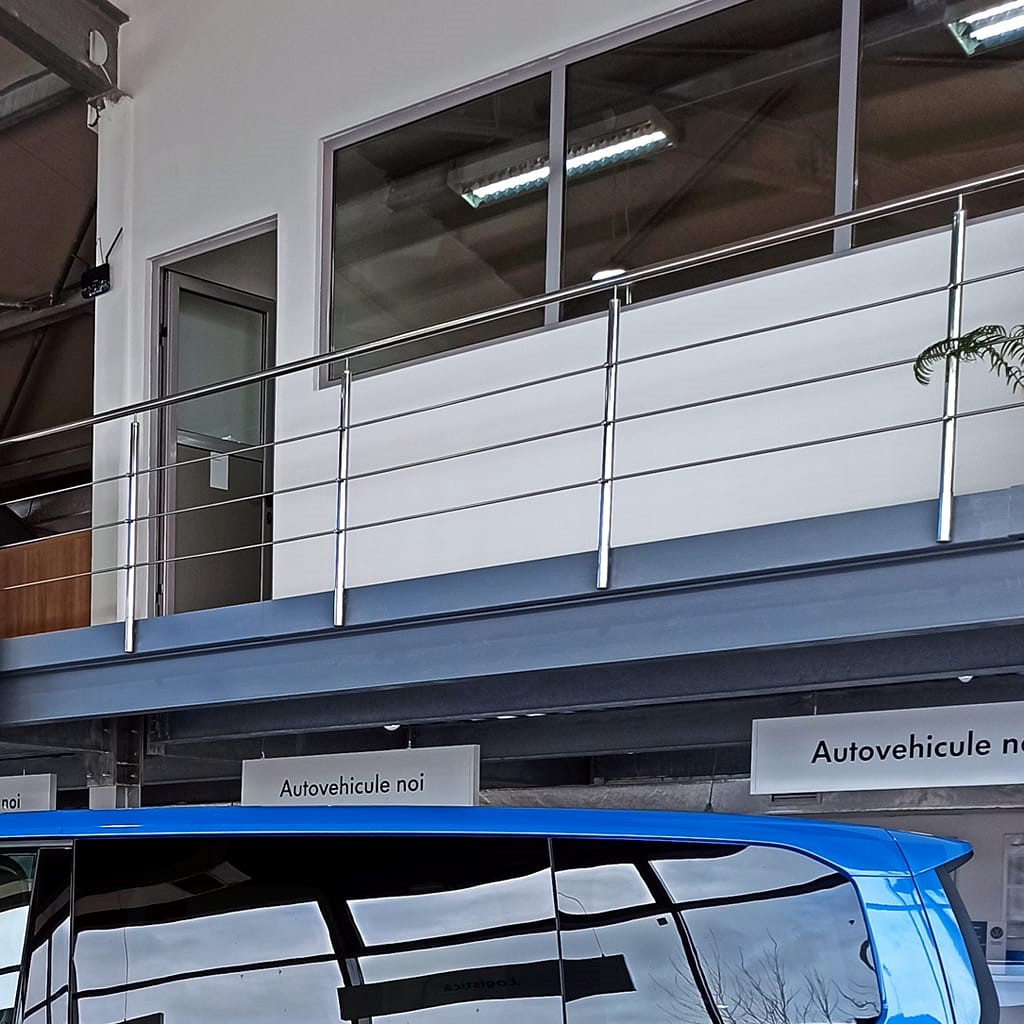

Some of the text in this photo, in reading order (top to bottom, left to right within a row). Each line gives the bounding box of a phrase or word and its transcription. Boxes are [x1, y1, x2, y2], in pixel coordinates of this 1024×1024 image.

[811, 731, 1024, 764] Autovehicule n
[280, 773, 424, 798] Autovehicule noi
[2, 793, 20, 809] noi
